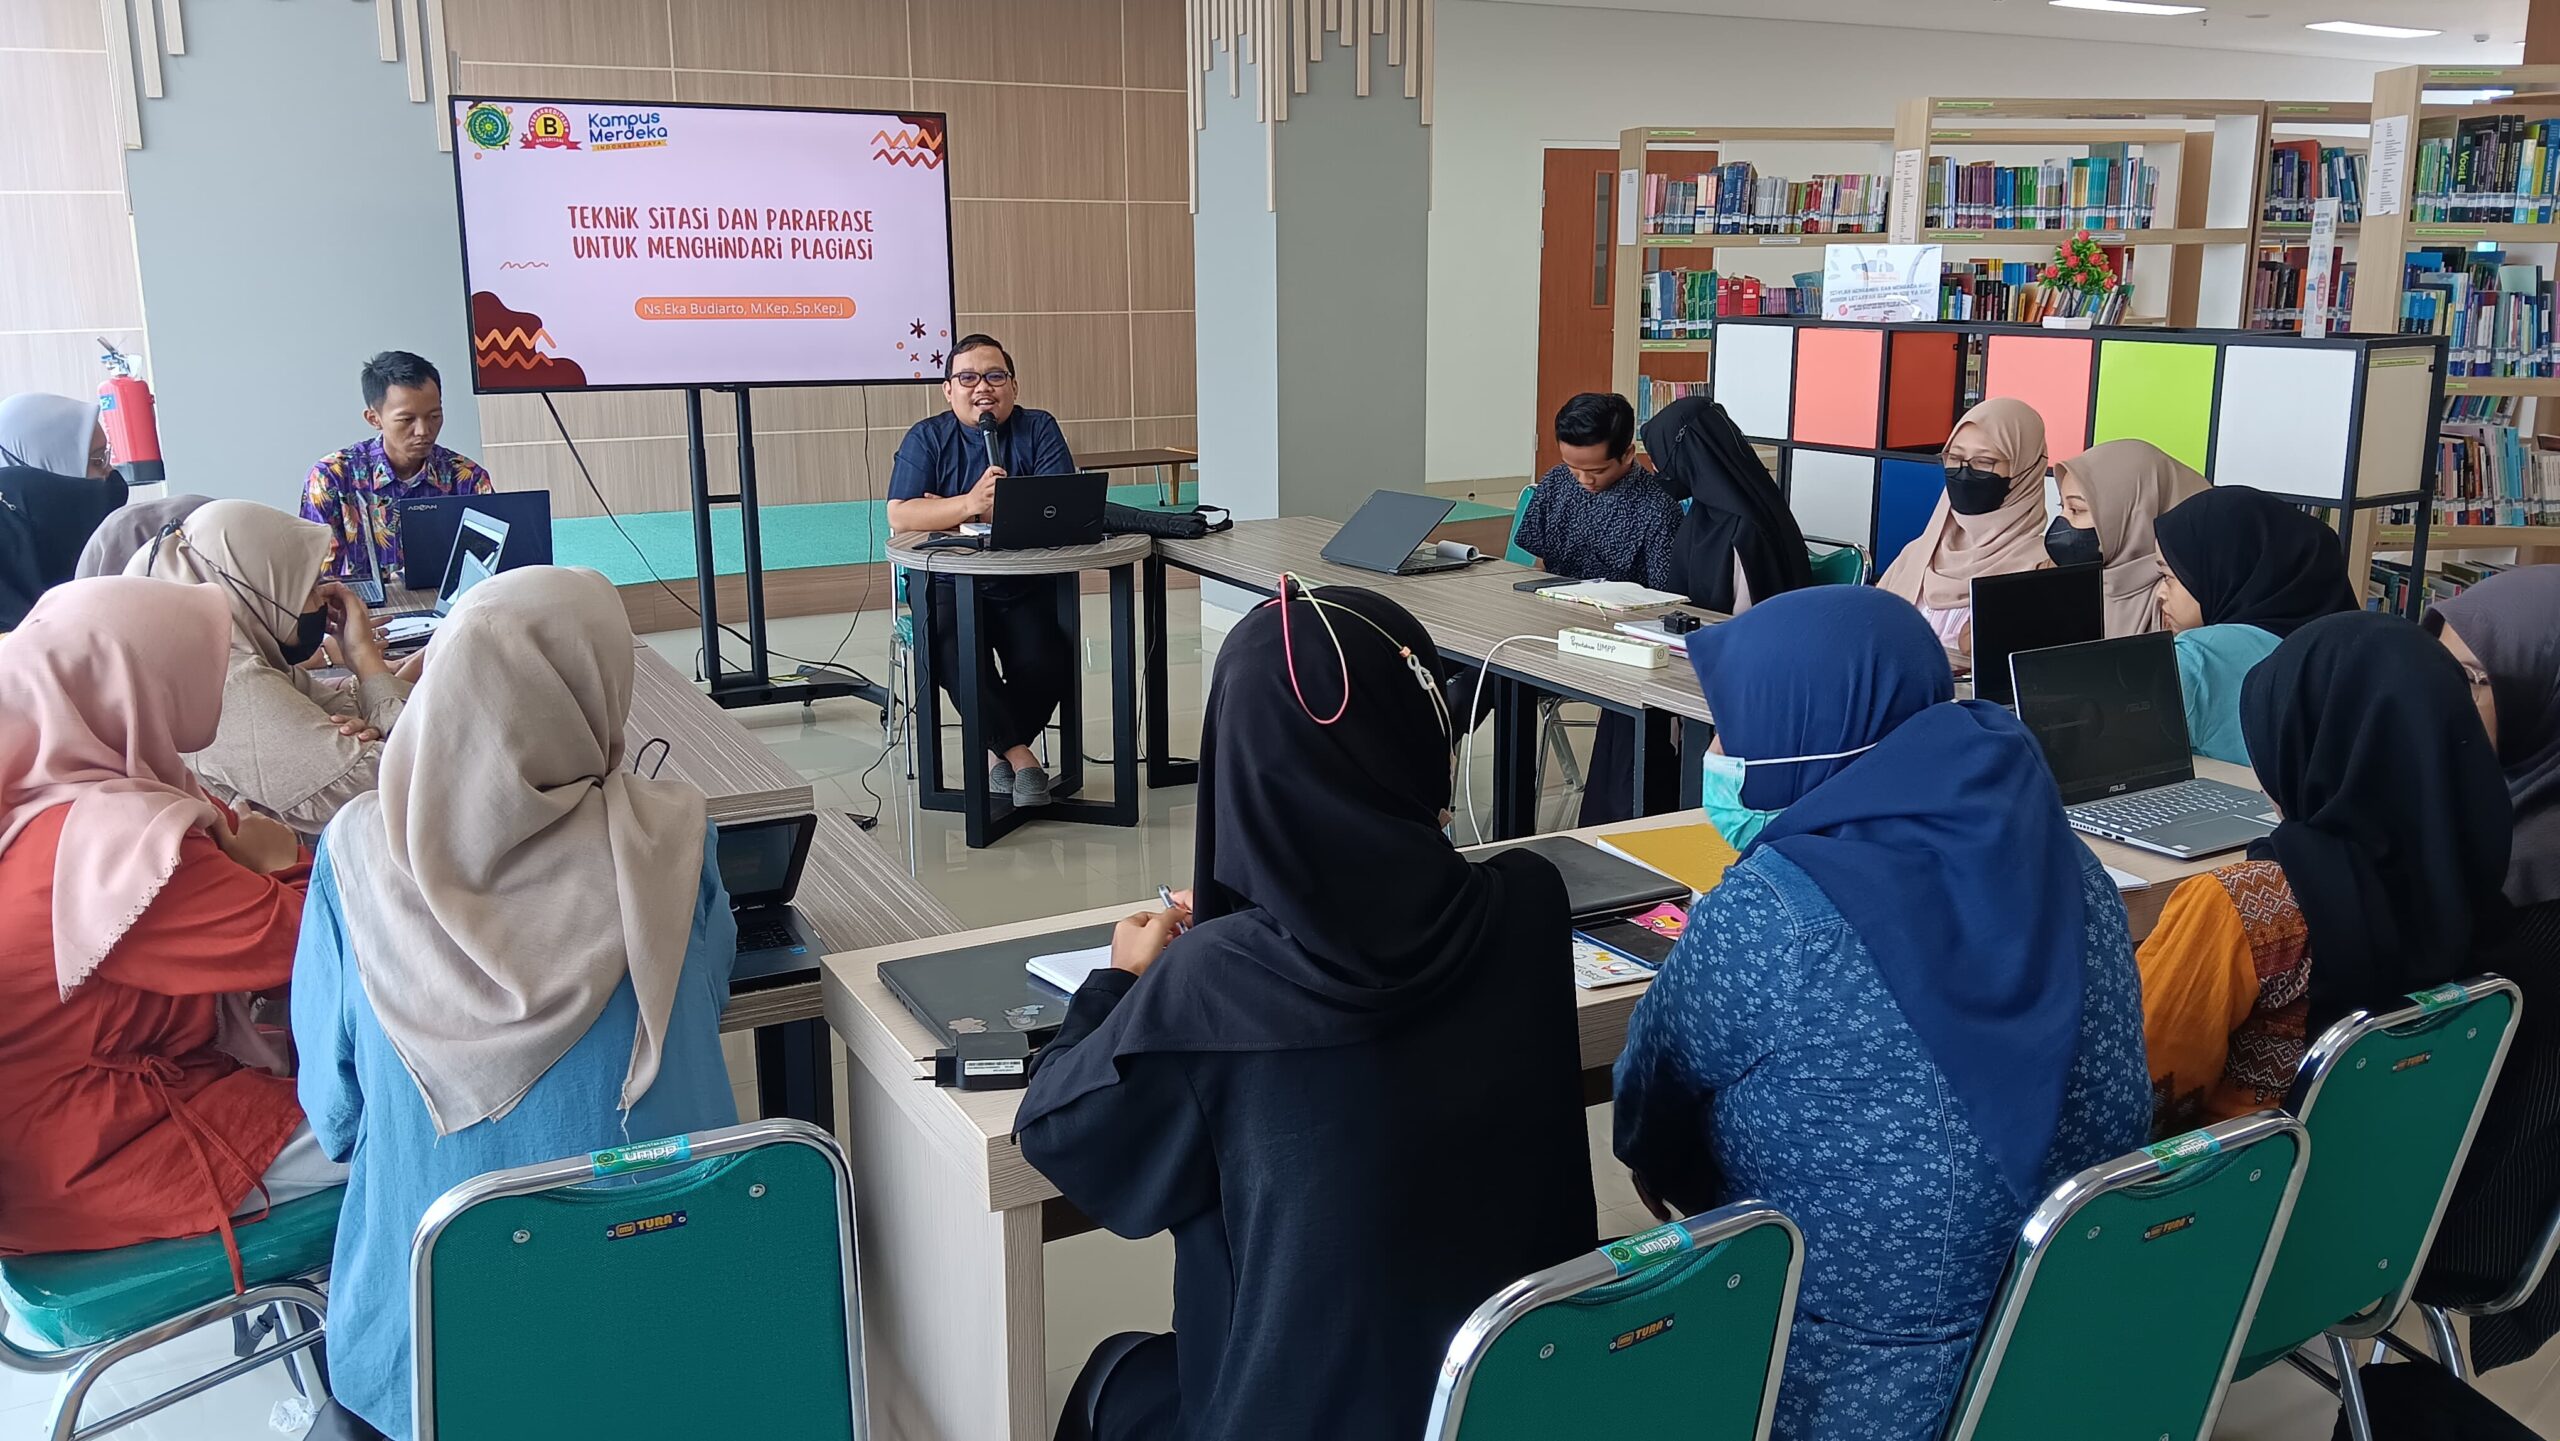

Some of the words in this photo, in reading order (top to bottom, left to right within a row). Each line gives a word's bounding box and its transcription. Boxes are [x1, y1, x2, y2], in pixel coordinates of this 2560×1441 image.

[543, 117, 557, 135] B
[588, 112, 660, 129] Kampus
[589, 125, 668, 143] Merdeka
[718, 208, 758, 231] DAN
[766, 209, 874, 232] PARAFRASE
[572, 236, 638, 259] UNTUK
[644, 303, 687, 315] Ns.Eka
[691, 303, 747, 317] Budiarto,
[2109, 783, 2126, 793] ASUS
[623, 1145, 679, 1163] umpp
[637, 1215, 673, 1230] TURA
[1633, 1230, 1682, 1256] umpp
